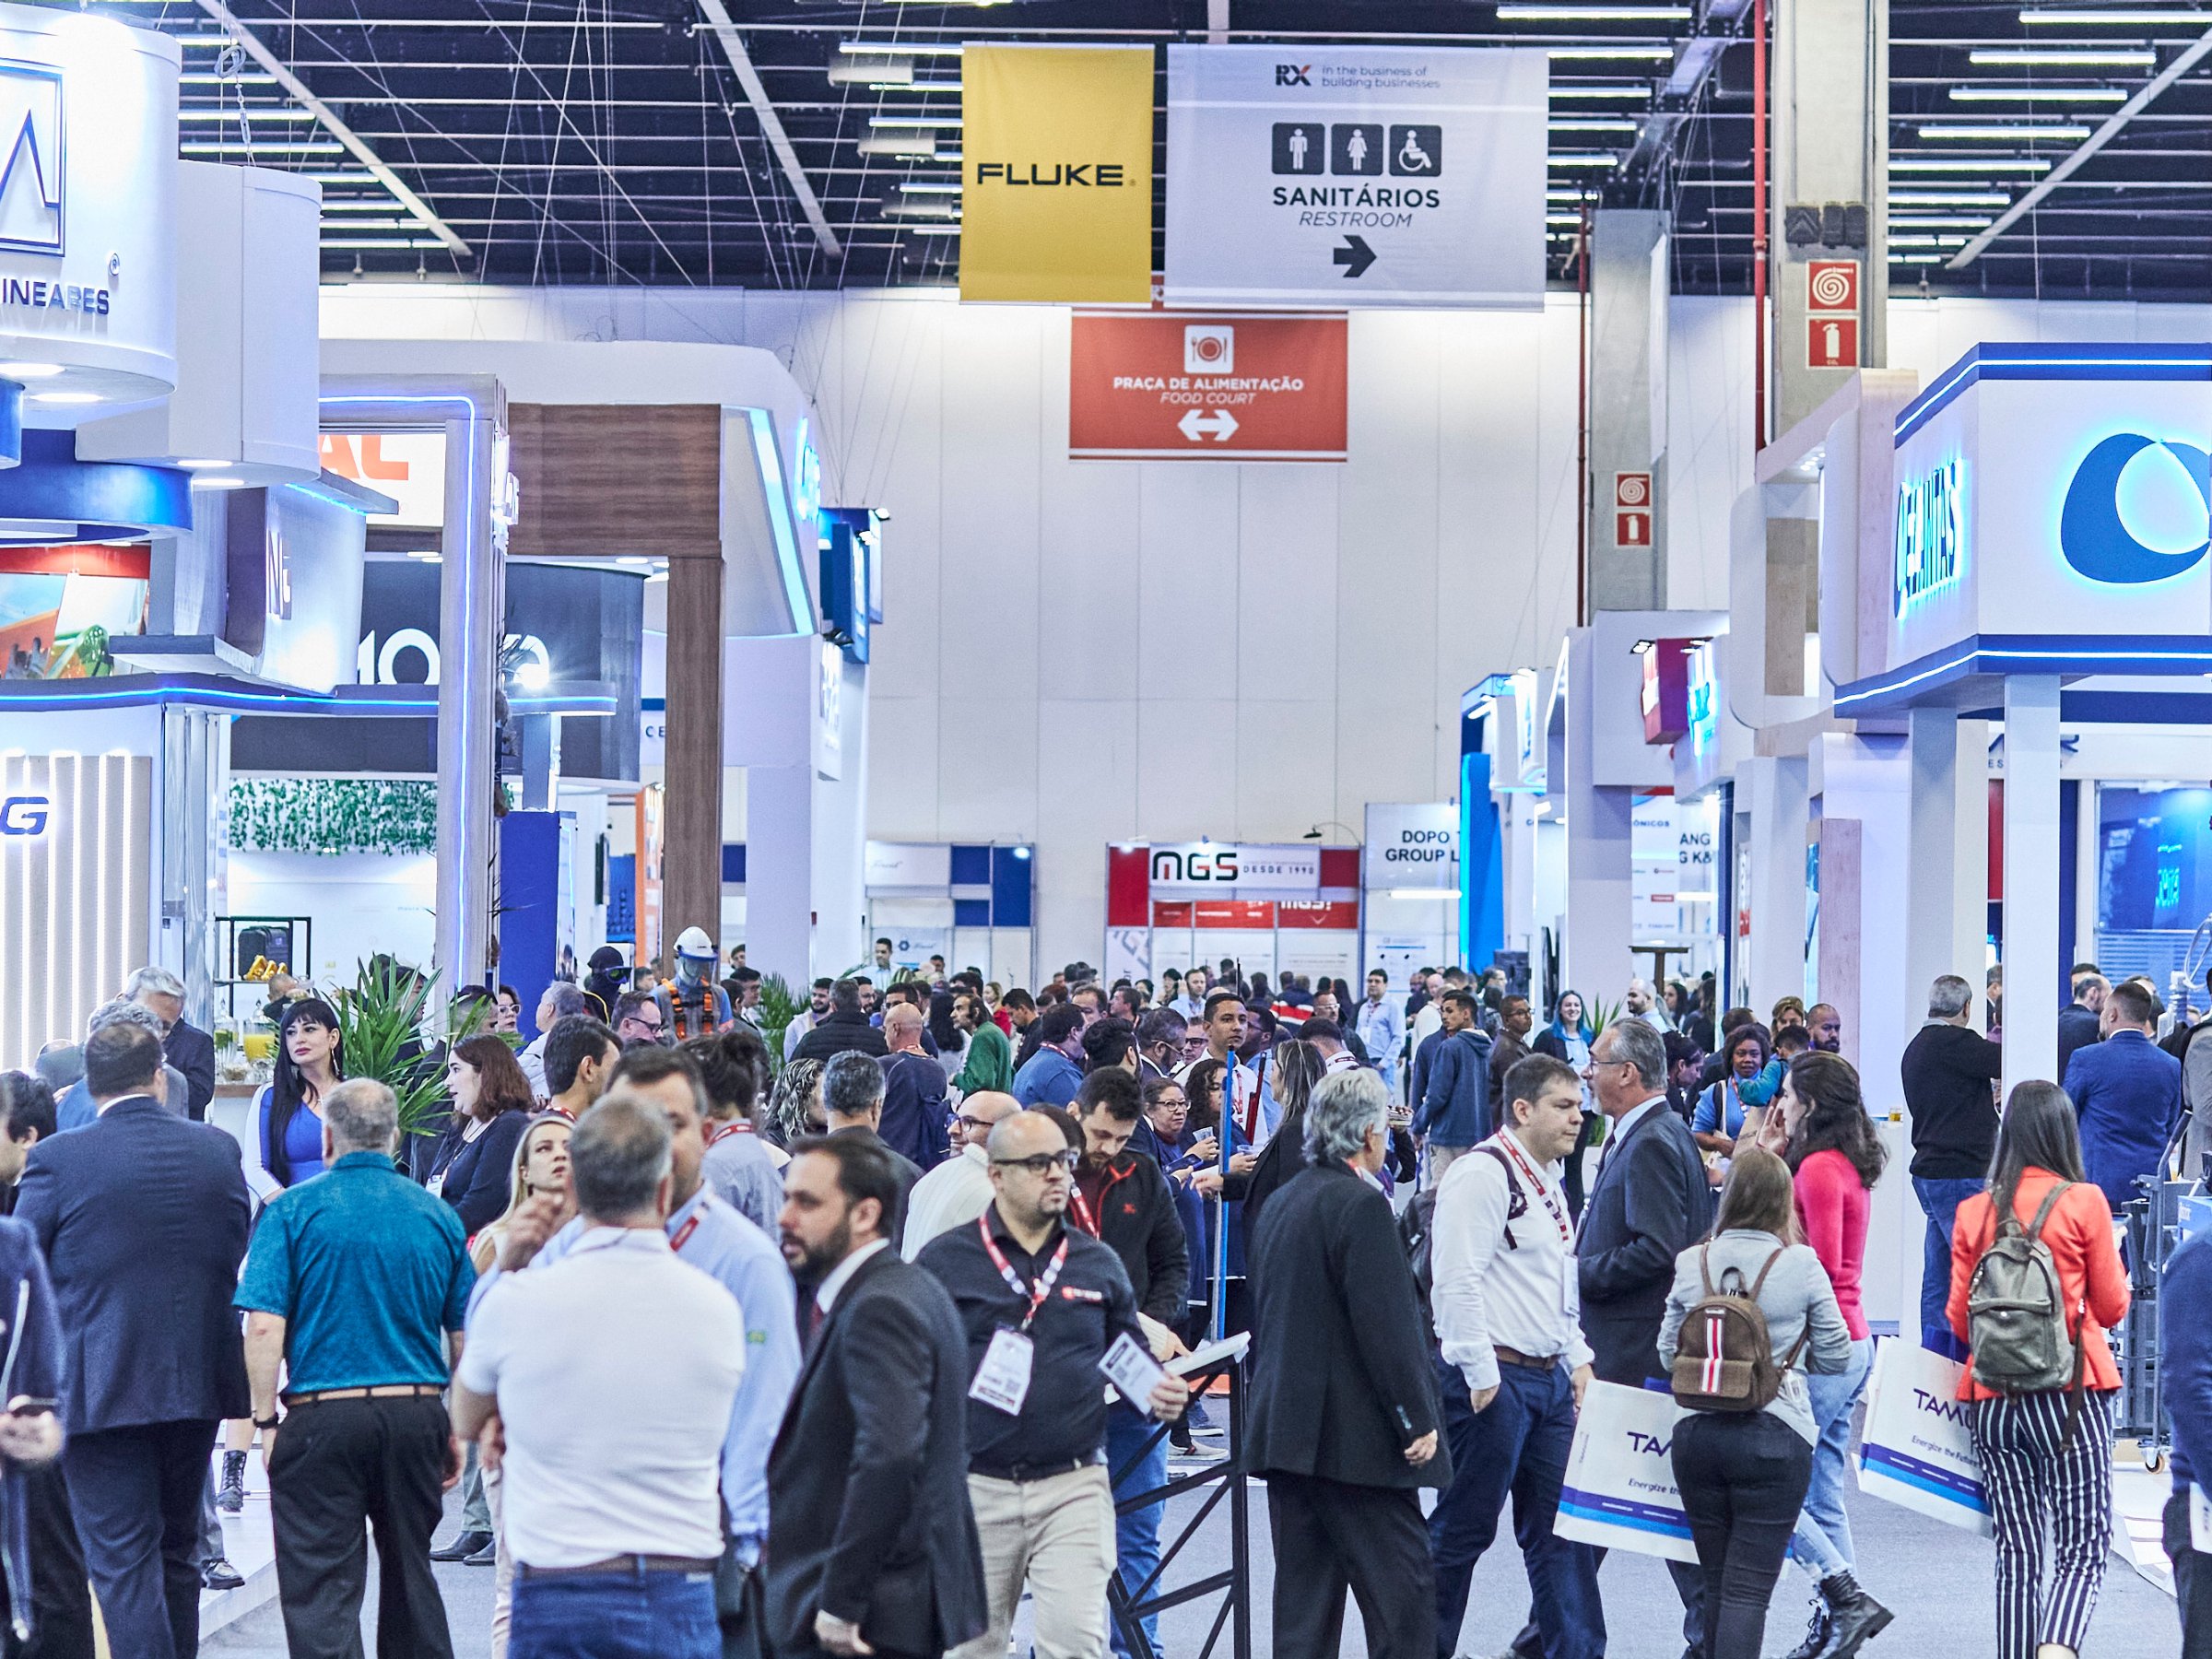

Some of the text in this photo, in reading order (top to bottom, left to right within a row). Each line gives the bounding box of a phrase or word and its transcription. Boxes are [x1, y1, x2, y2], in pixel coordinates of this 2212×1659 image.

[1276, 64, 1311, 86] RX
[1336, 65, 1357, 75] the
[1360, 66, 1411, 76] business
[1415, 66, 1427, 76] of
[1322, 77, 1441, 88] building businesses
[977, 163, 1124, 186] FLUKE
[1273, 182, 1441, 208] SANITÁRIOS
[1299, 211, 1412, 228] RESTROOM
[1113, 376, 1304, 392] PRAÇA DE ALIMENTAÇÃO
[1159, 392, 1256, 405] FOOD COURT
[1402, 830, 1450, 843] DOPO
[1385, 848, 1445, 862] GROUP
[1152, 851, 1238, 881] MGS
[1243, 865, 1283, 874] DESDE
[1288, 865, 1314, 875] 1990
[1628, 1477, 1667, 1493] Energize
